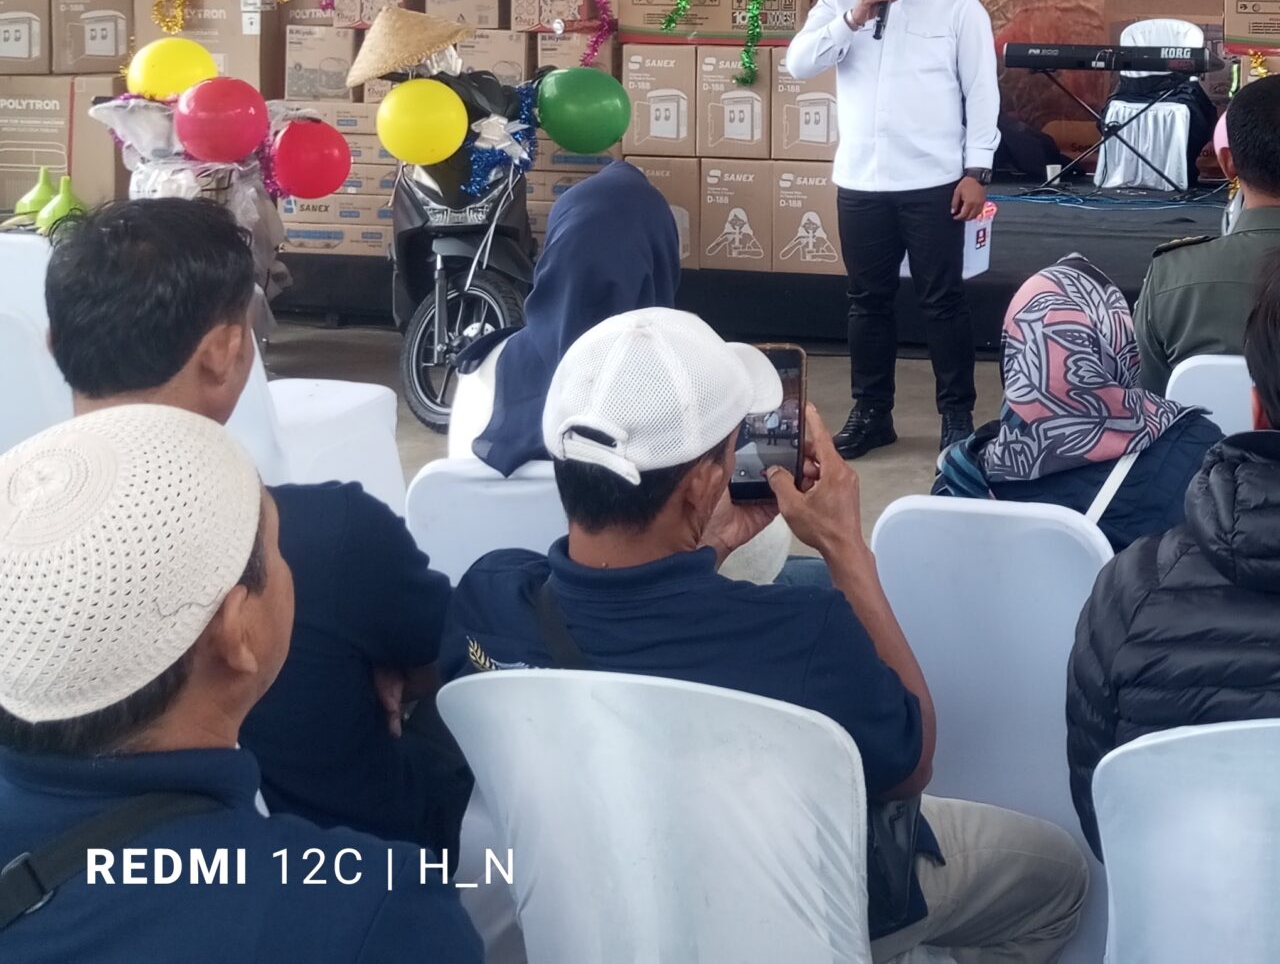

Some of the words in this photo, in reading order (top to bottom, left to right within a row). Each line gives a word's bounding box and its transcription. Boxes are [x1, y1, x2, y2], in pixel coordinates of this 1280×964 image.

[1161, 48, 1191, 59] KORG
[644, 59, 676, 68] SANEX
[718, 60, 743, 69] SANE
[628, 82, 650, 90] D-188
[703, 83, 725, 91] D-188
[778, 84, 800, 93] D-188
[724, 173, 755, 183] SANEX
[796, 177, 827, 186] SANEX
[707, 196, 729, 205] D-188
[780, 200, 802, 208] D-188
[299, 204, 330, 213] SANEX
